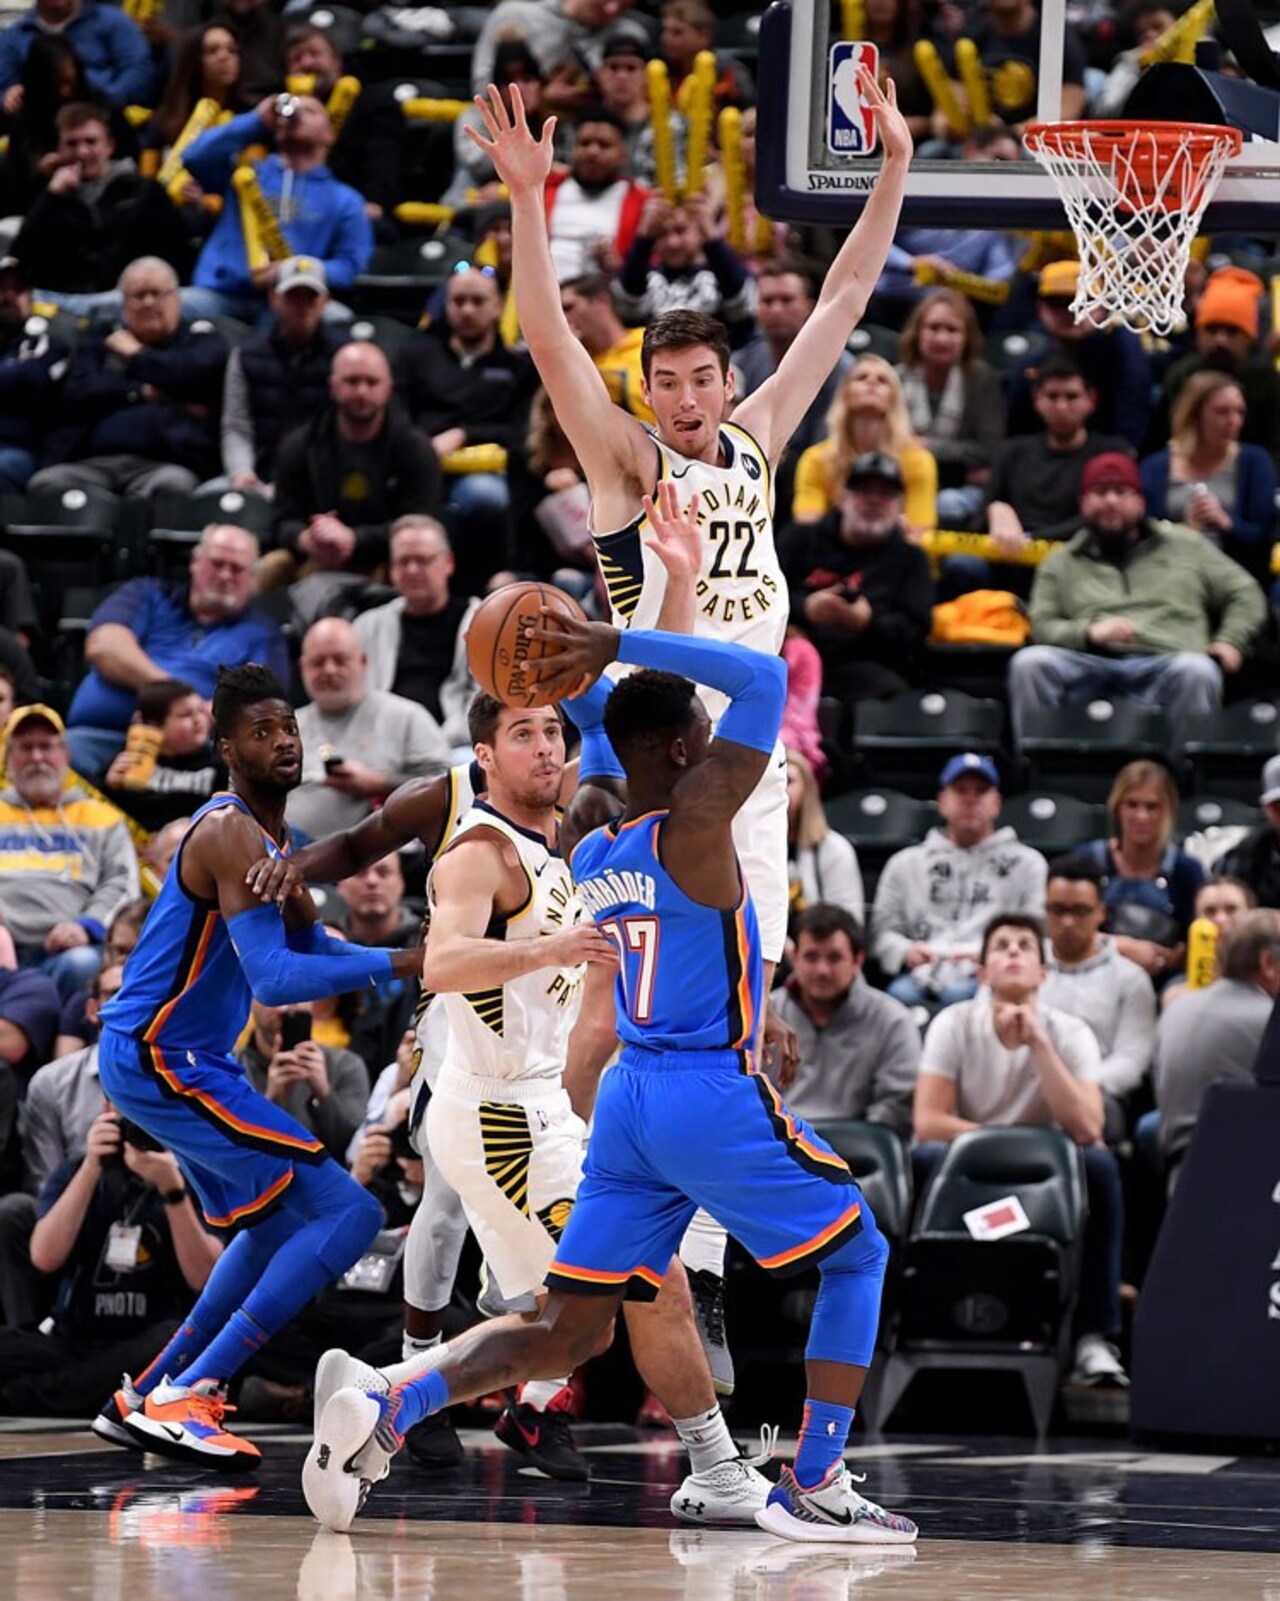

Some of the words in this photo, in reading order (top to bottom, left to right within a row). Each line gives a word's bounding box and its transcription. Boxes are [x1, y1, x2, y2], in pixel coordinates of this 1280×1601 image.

[834, 128, 858, 148] NBA
[683, 482, 768, 534] NDIANA
[709, 520, 759, 579] 22
[696, 574, 778, 623] PACERS
[597, 915, 661, 1024] 17
[94, 1292, 147, 1317] PHOTO
